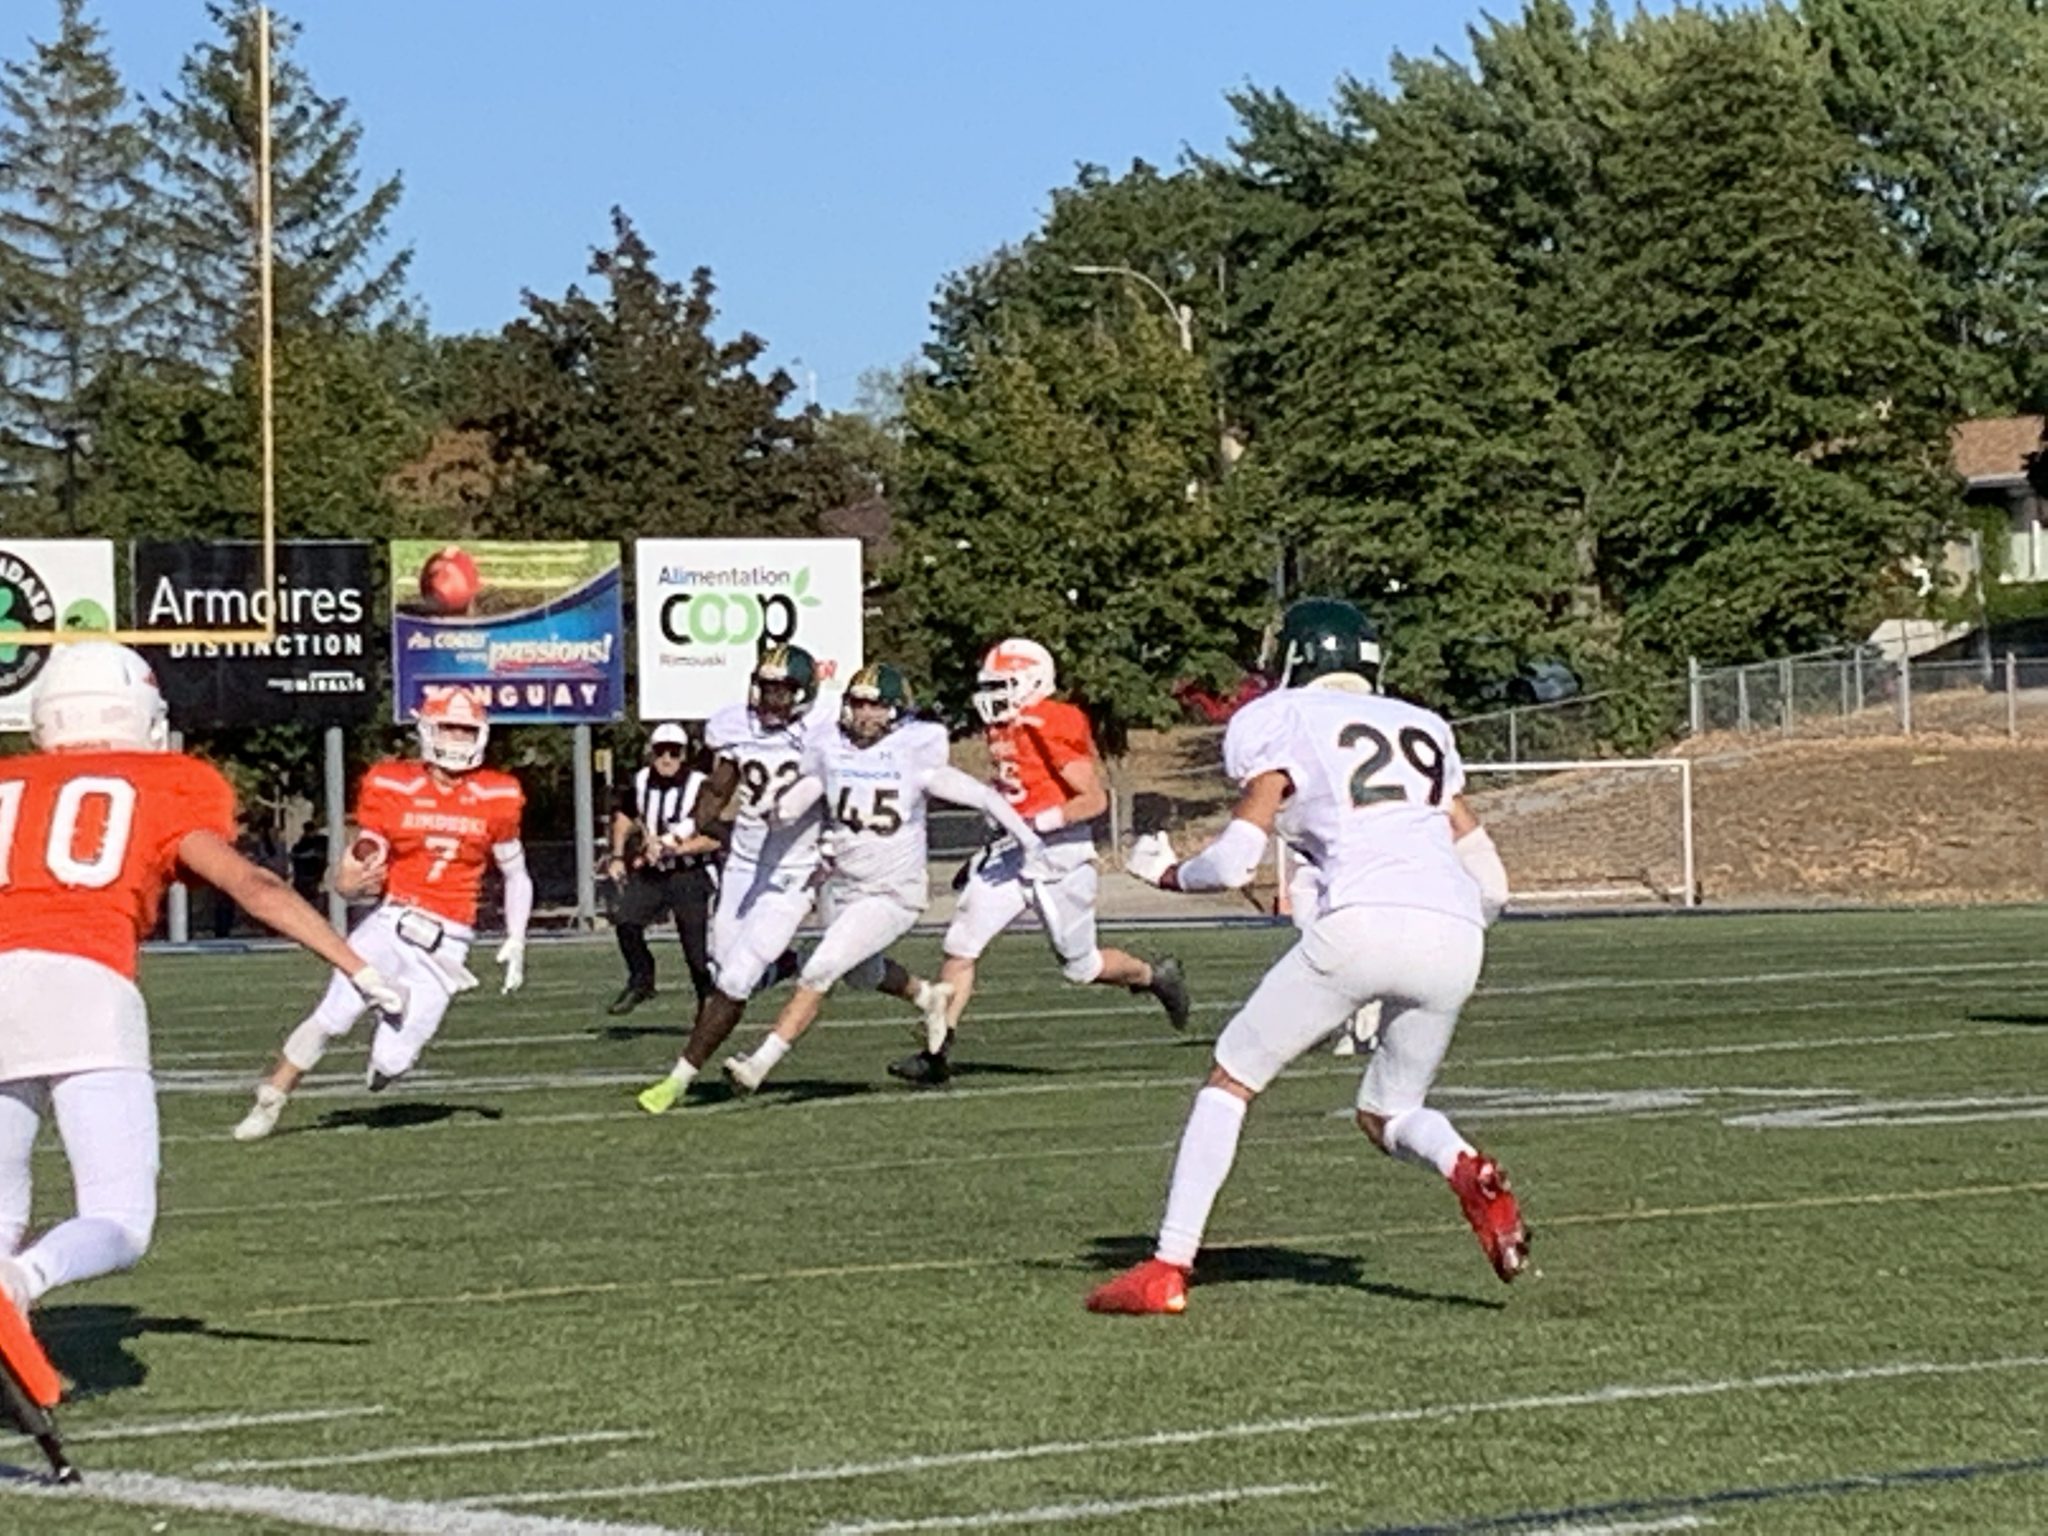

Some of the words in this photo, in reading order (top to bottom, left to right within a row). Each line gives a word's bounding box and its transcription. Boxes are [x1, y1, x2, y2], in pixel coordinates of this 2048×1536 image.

[658, 566, 791, 586] Alimentation
[149, 575, 363, 625] Armoires
[169, 633, 363, 658] DISTINCTION
[488, 632, 613, 671] passions!
[423, 684, 598, 706] TNGUAY
[742, 758, 802, 806] 92
[1337, 723, 1446, 807] 29
[0, 774, 138, 888] 10
[837, 786, 903, 836] 45
[425, 836, 460, 882] 7
